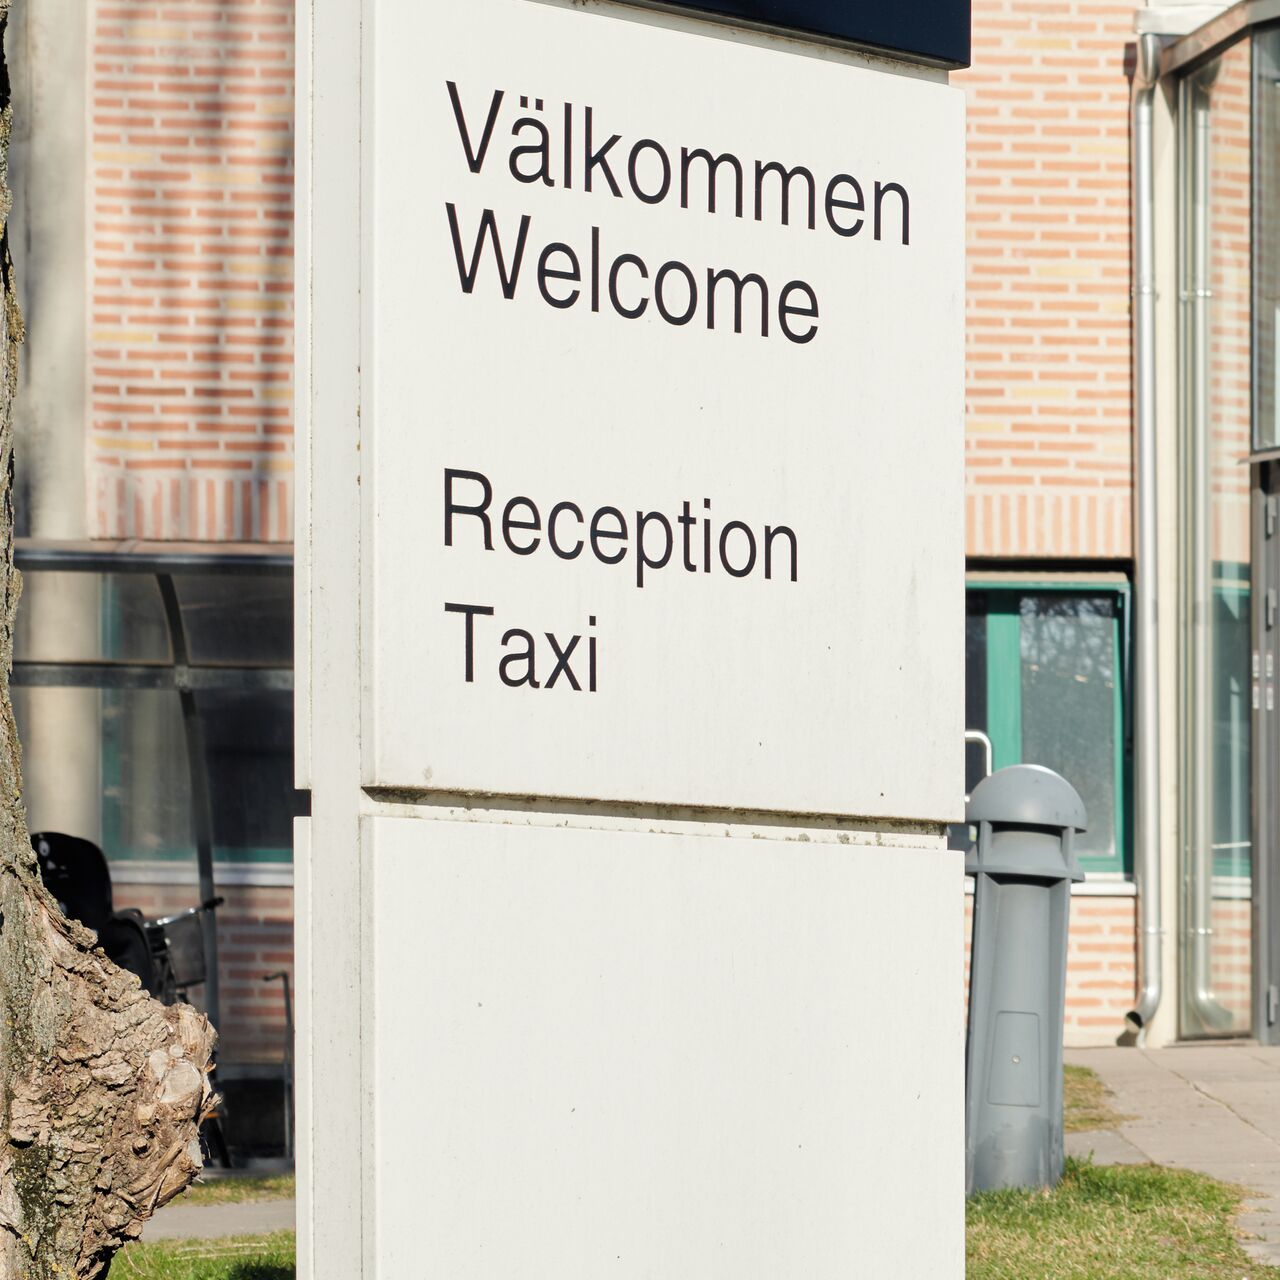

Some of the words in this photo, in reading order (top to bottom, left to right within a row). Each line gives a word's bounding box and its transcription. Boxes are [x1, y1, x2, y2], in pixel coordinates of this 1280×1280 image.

[445, 80, 911, 246] Välkommen
[445, 203, 820, 344] Welcome
[443, 468, 799, 587] Reception
[444, 603, 599, 693] Taxi
